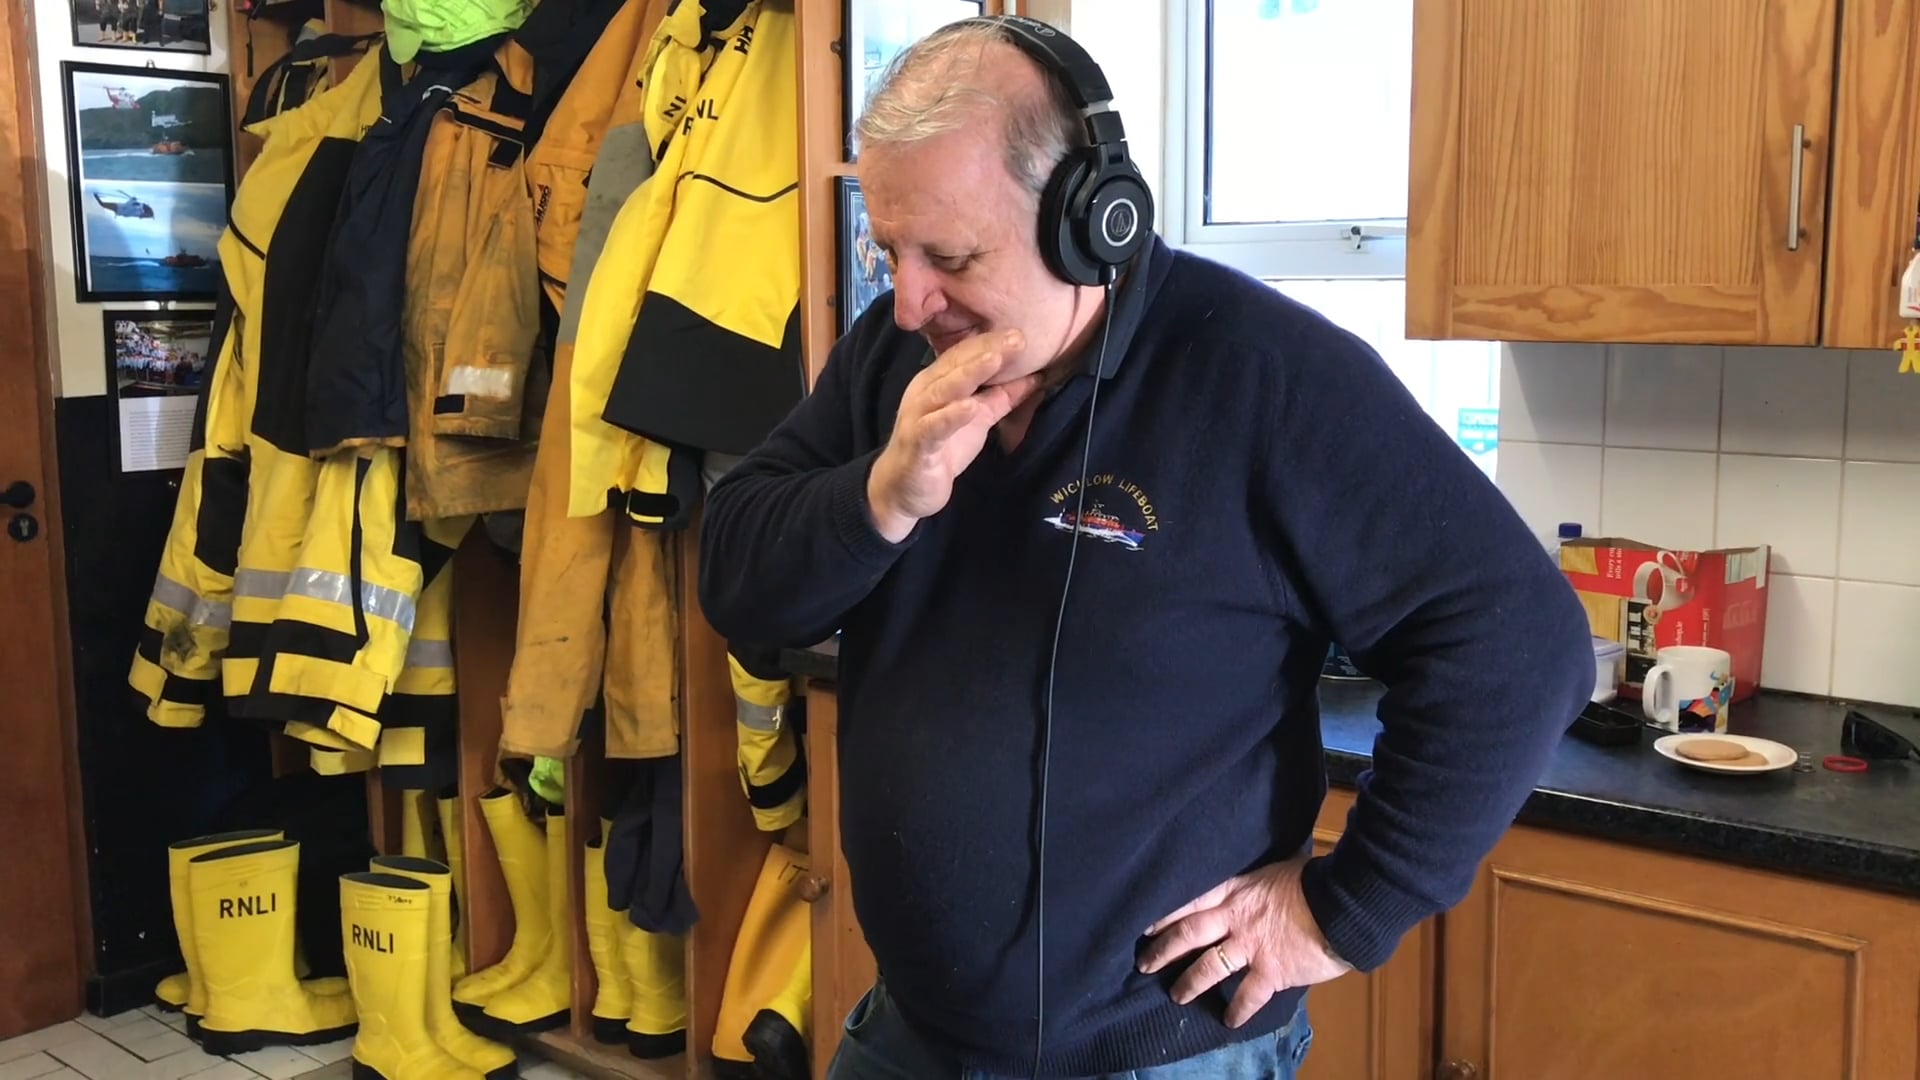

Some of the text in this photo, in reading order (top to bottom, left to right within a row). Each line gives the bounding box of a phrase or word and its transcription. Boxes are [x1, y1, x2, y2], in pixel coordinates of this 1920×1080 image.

[1049, 473, 1159, 532] WICLOW LIFEBOAT
[219, 892, 276, 920] RNLI
[352, 923, 394, 955] RNLI
